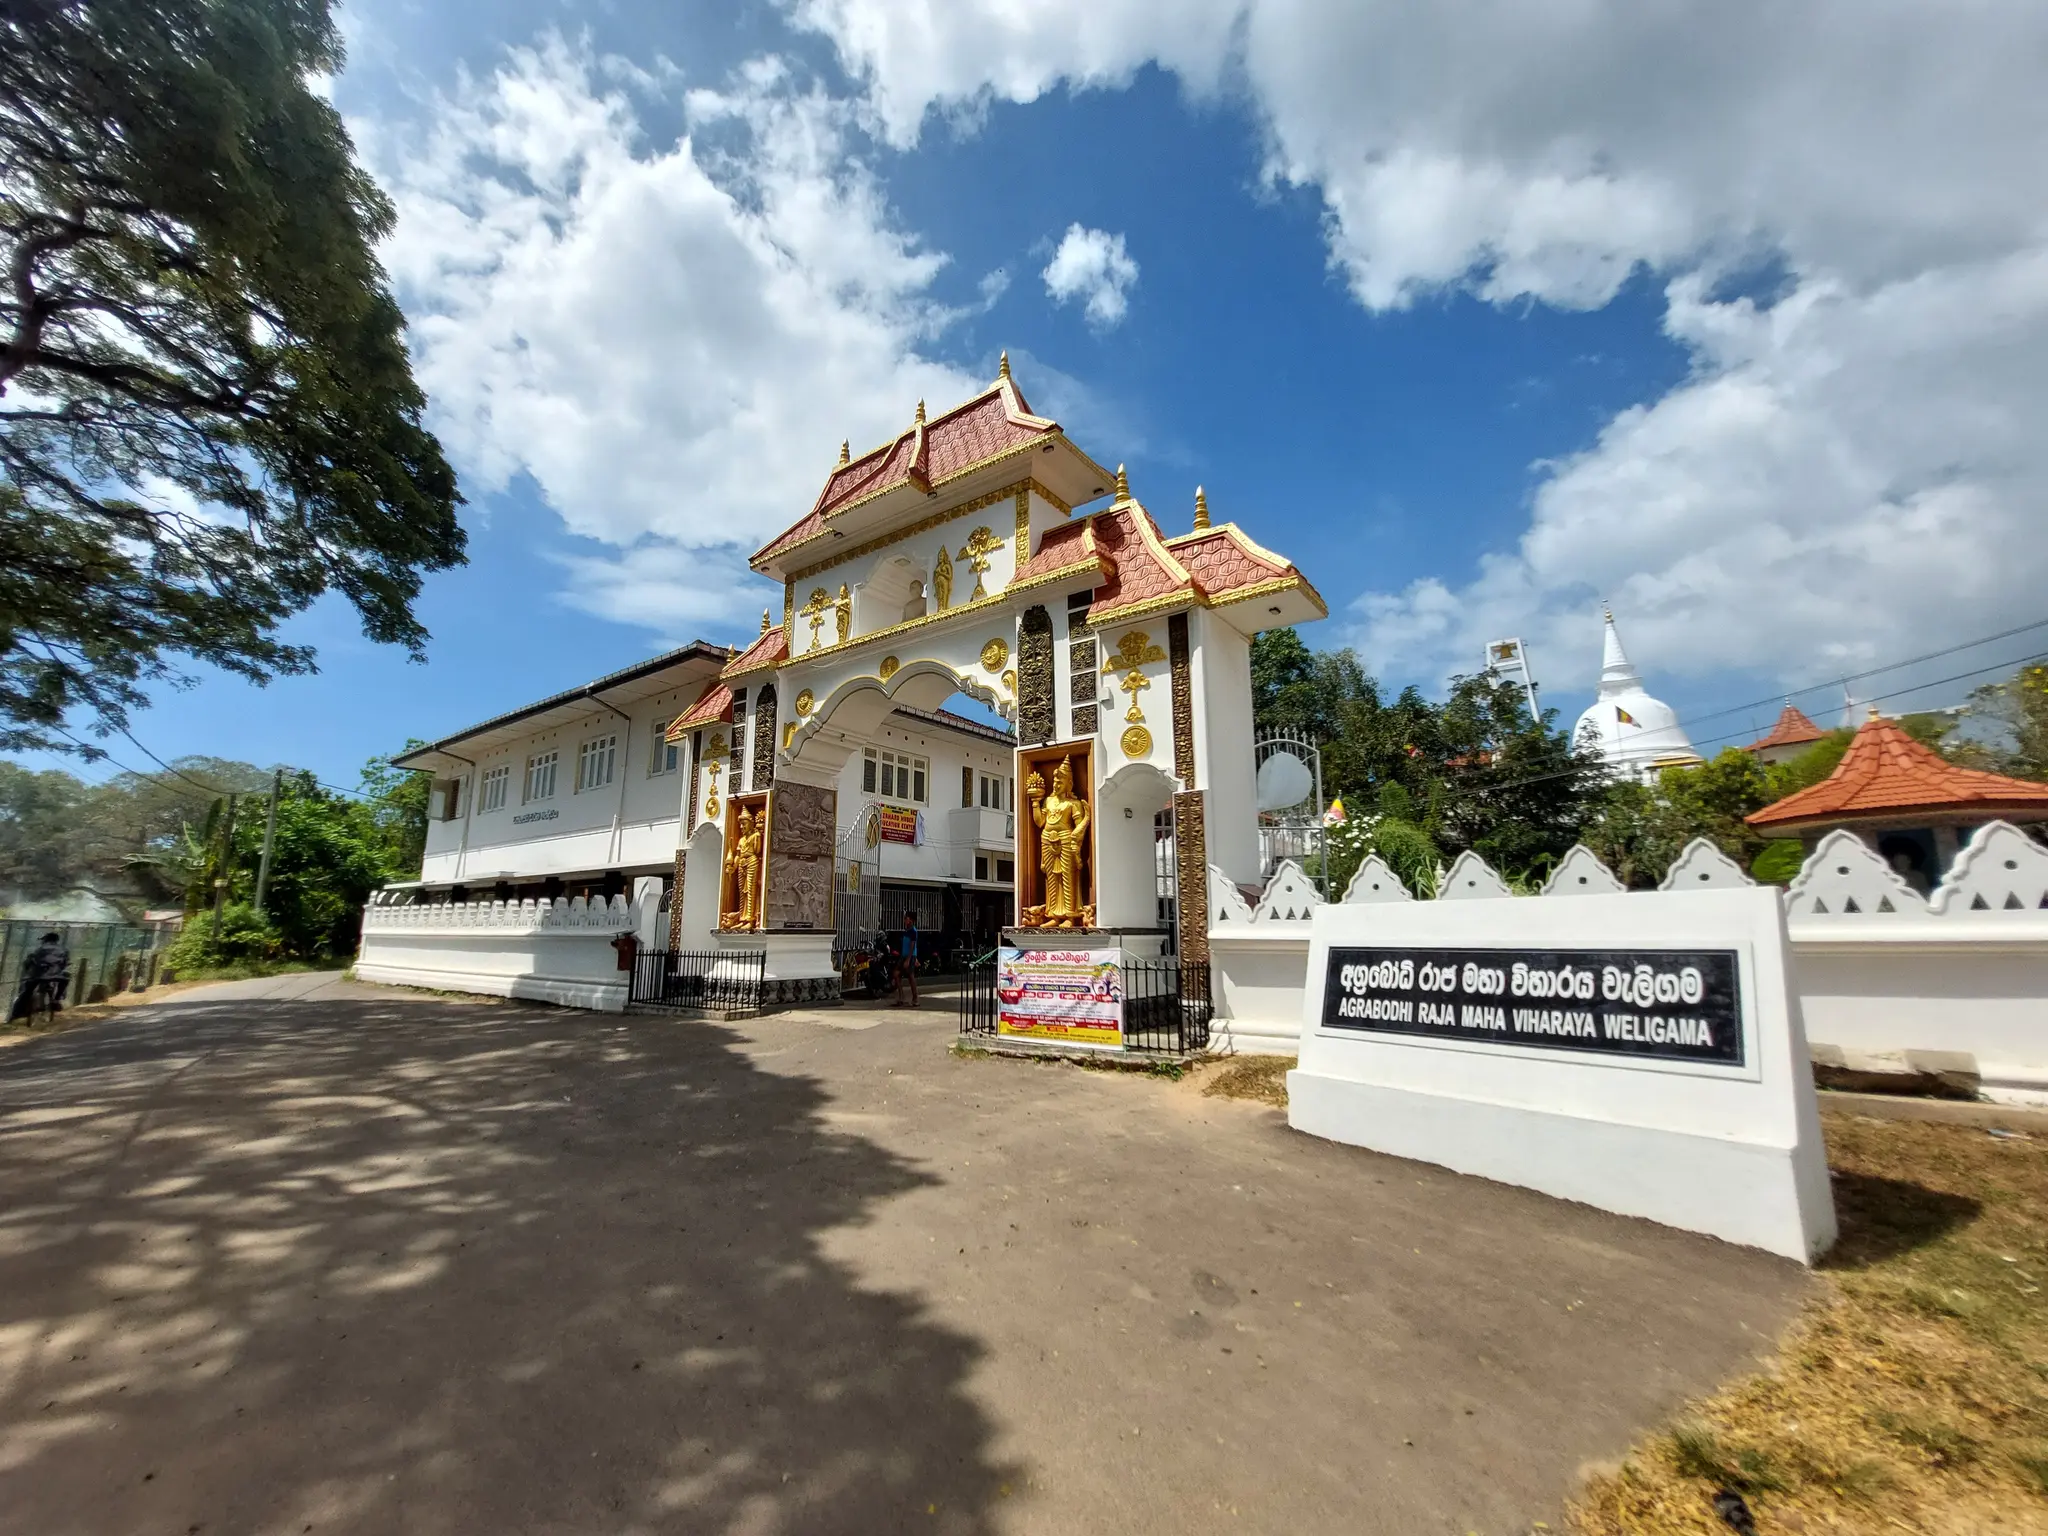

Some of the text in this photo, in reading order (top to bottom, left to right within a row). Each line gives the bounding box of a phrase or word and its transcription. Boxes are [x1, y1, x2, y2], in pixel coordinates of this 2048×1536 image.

[1340, 959, 1704, 1008] අග්‍රබෝධි රාජ මහා විහාරය වැලිගම
[1338, 997, 1714, 1047] AGRABODHI RAJA MAHA VIHARAYA WELIGAMA
